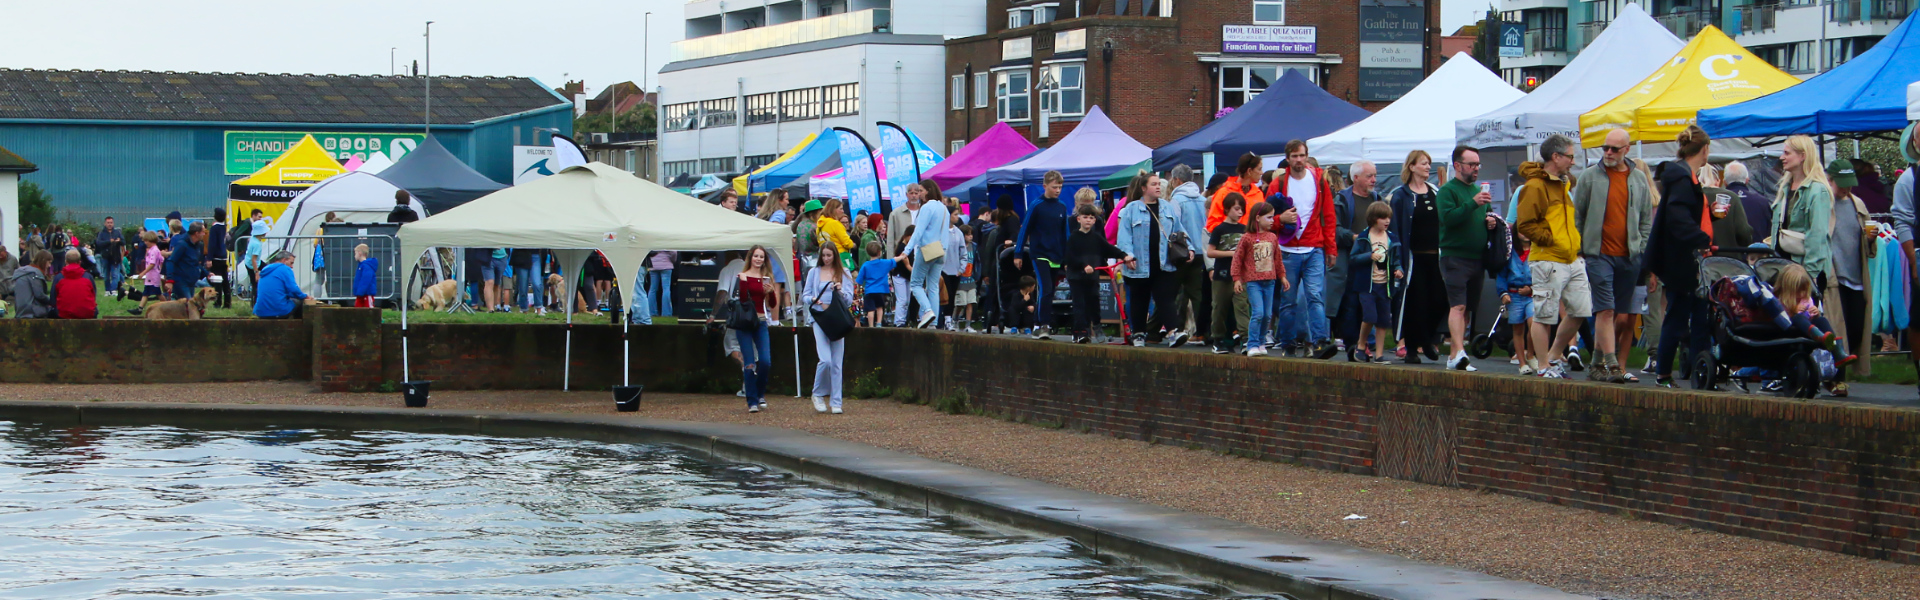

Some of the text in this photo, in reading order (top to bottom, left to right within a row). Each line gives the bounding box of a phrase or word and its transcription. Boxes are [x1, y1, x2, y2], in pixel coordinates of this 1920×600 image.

[1386, 11, 1399, 19] The
[1364, 18, 1419, 30] Gather Inn
[1247, 27, 1268, 35] TABLE
[1225, 43, 1257, 51] Function
[1259, 43, 1280, 51] Room
[1294, 44, 1313, 52] Hire!
[1655, 116, 1698, 126] www.c
[250, 189, 280, 198] PHOTO
[280, 190, 288, 198] &
